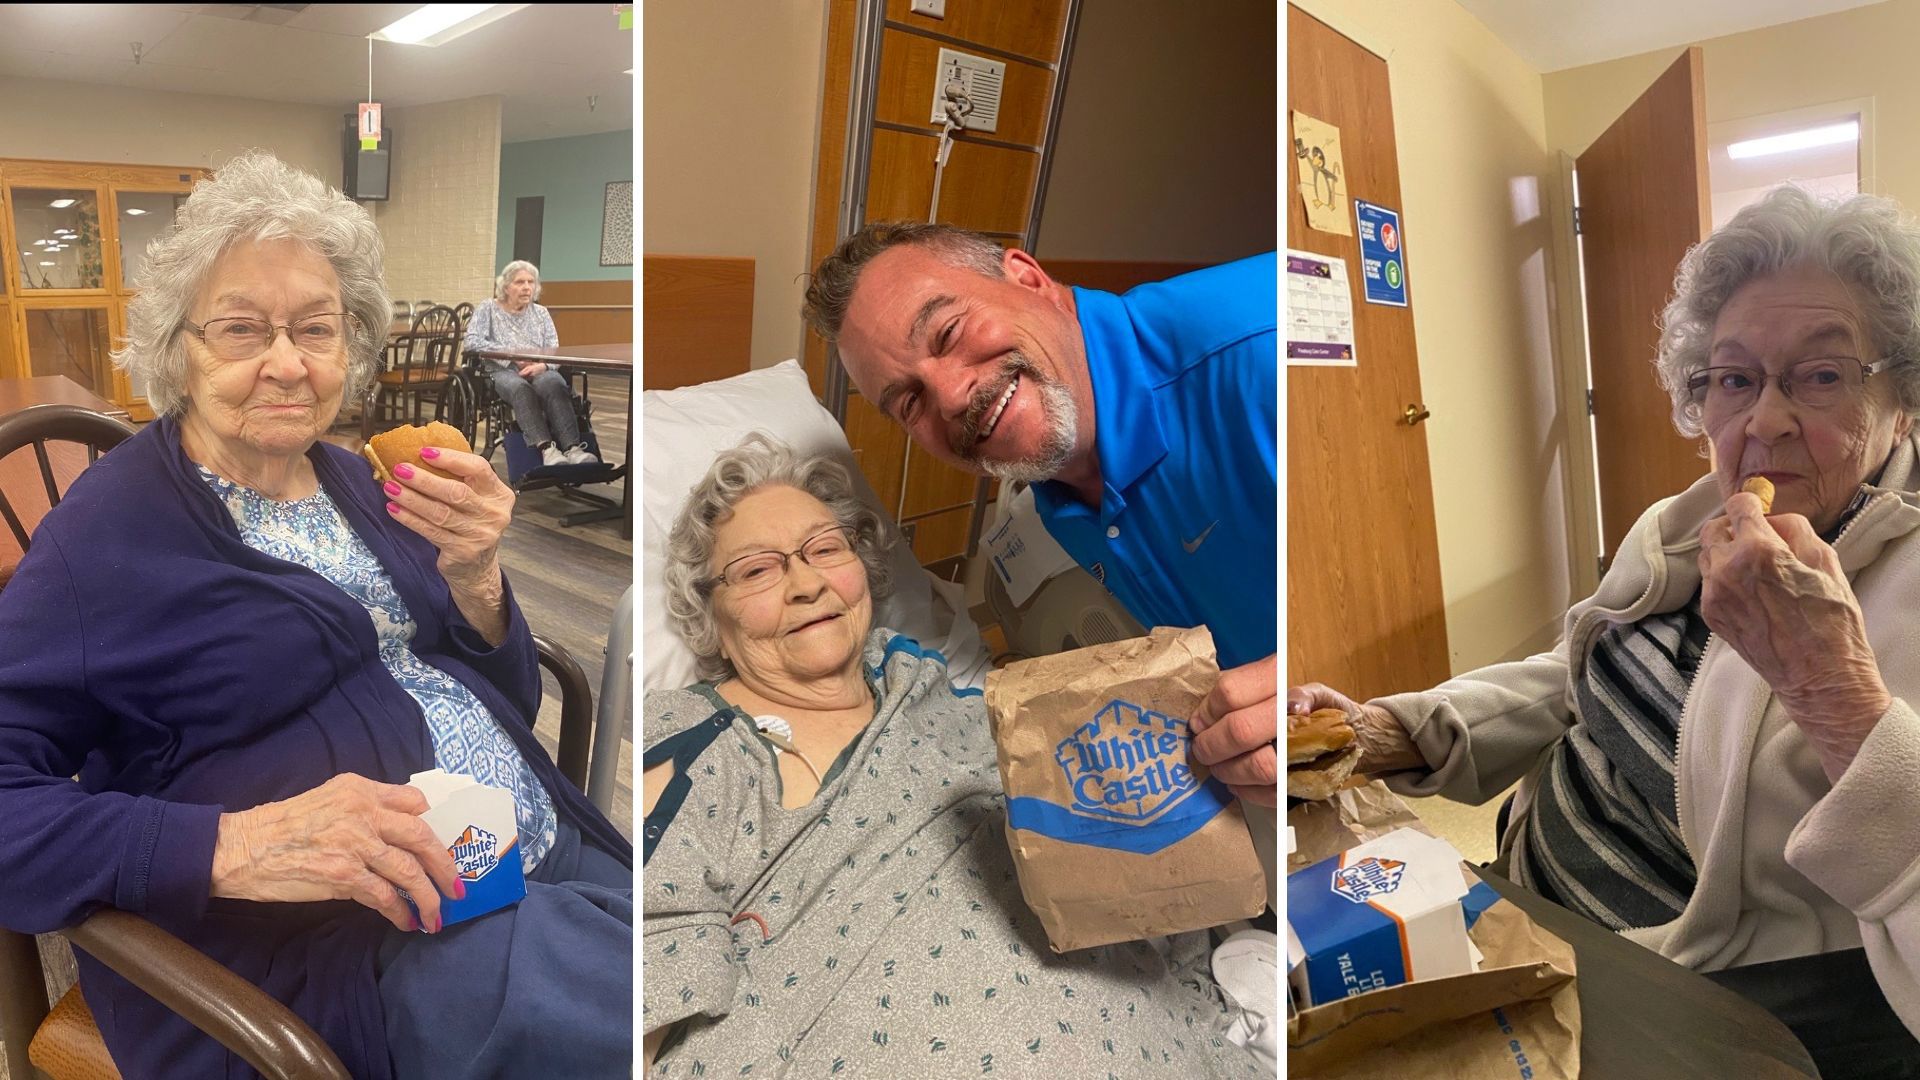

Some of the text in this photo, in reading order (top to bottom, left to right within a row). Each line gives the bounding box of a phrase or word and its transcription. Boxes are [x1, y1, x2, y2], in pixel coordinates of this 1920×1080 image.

[1073, 729, 1179, 774] White
[1073, 760, 1193, 807] Castle
[453, 838, 492, 861] White
[1339, 867, 1371, 898] Castle
[1360, 861, 1389, 891] White
[1337, 952, 1357, 986] YALE
